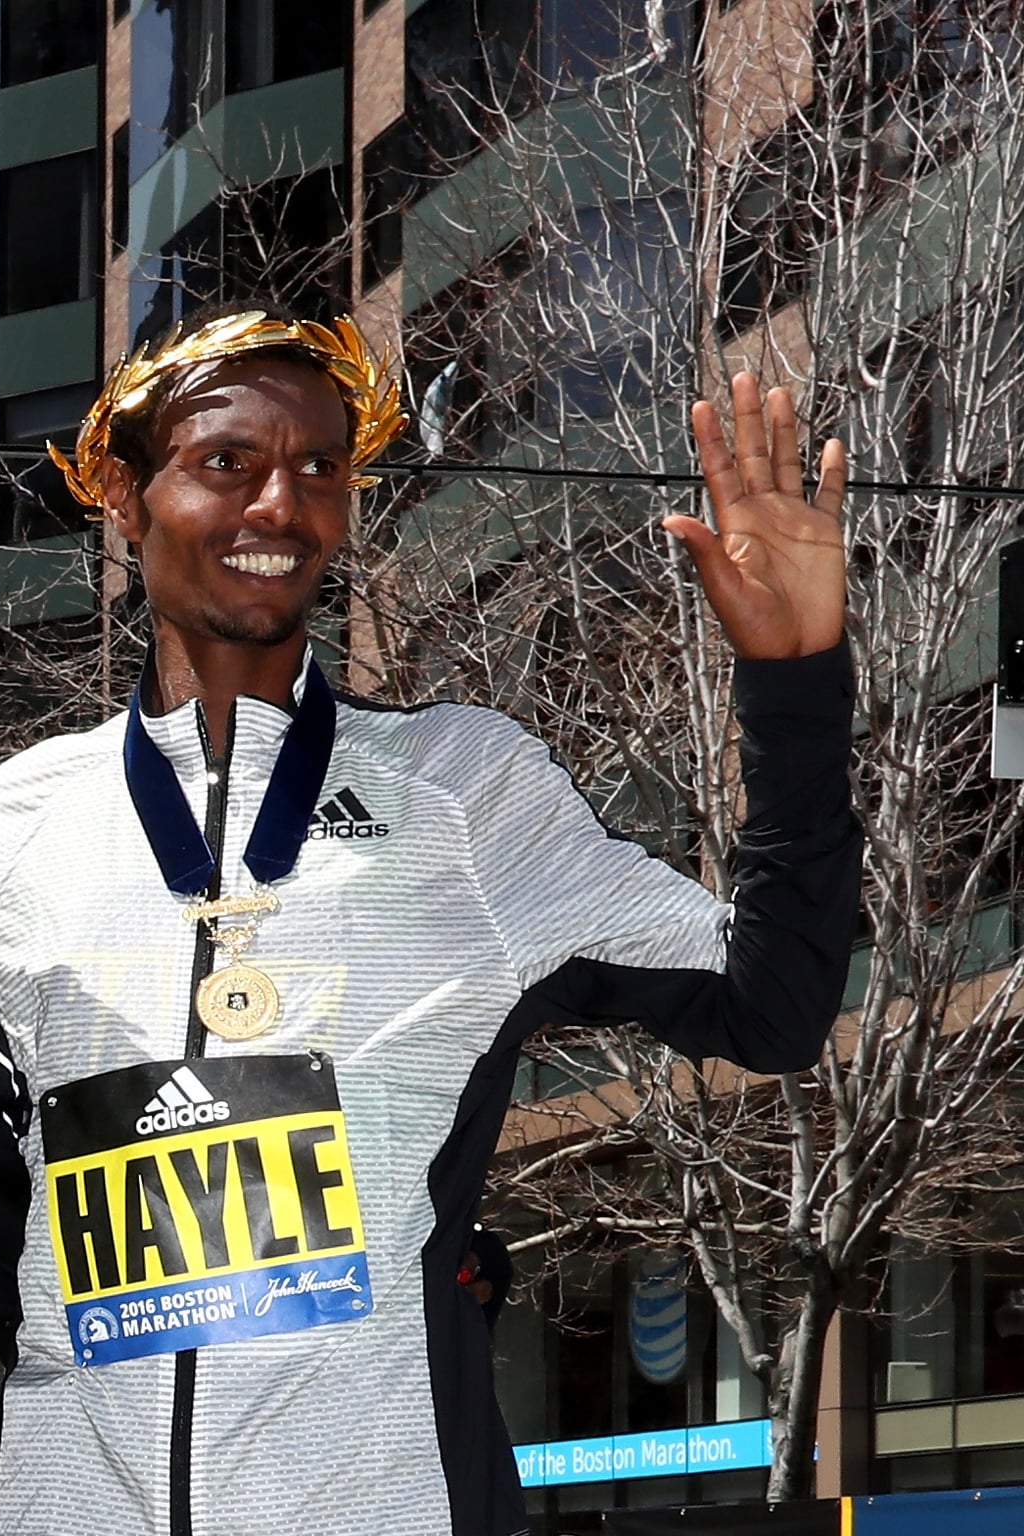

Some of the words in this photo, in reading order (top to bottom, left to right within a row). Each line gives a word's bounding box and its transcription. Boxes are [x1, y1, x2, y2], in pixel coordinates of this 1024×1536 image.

[303, 819, 390, 843] didas
[135, 1100, 231, 1136] adidas
[55, 1125, 354, 1296] HAYLE
[119, 1297, 156, 1319] 2016
[162, 1284, 233, 1313] BOSTON
[122, 1301, 236, 1338] MARATHON
[518, 1457, 535, 1479] of
[537, 1449, 566, 1476] the
[572, 1445, 635, 1473] Boston
[641, 1434, 737, 1468] Marathon.
